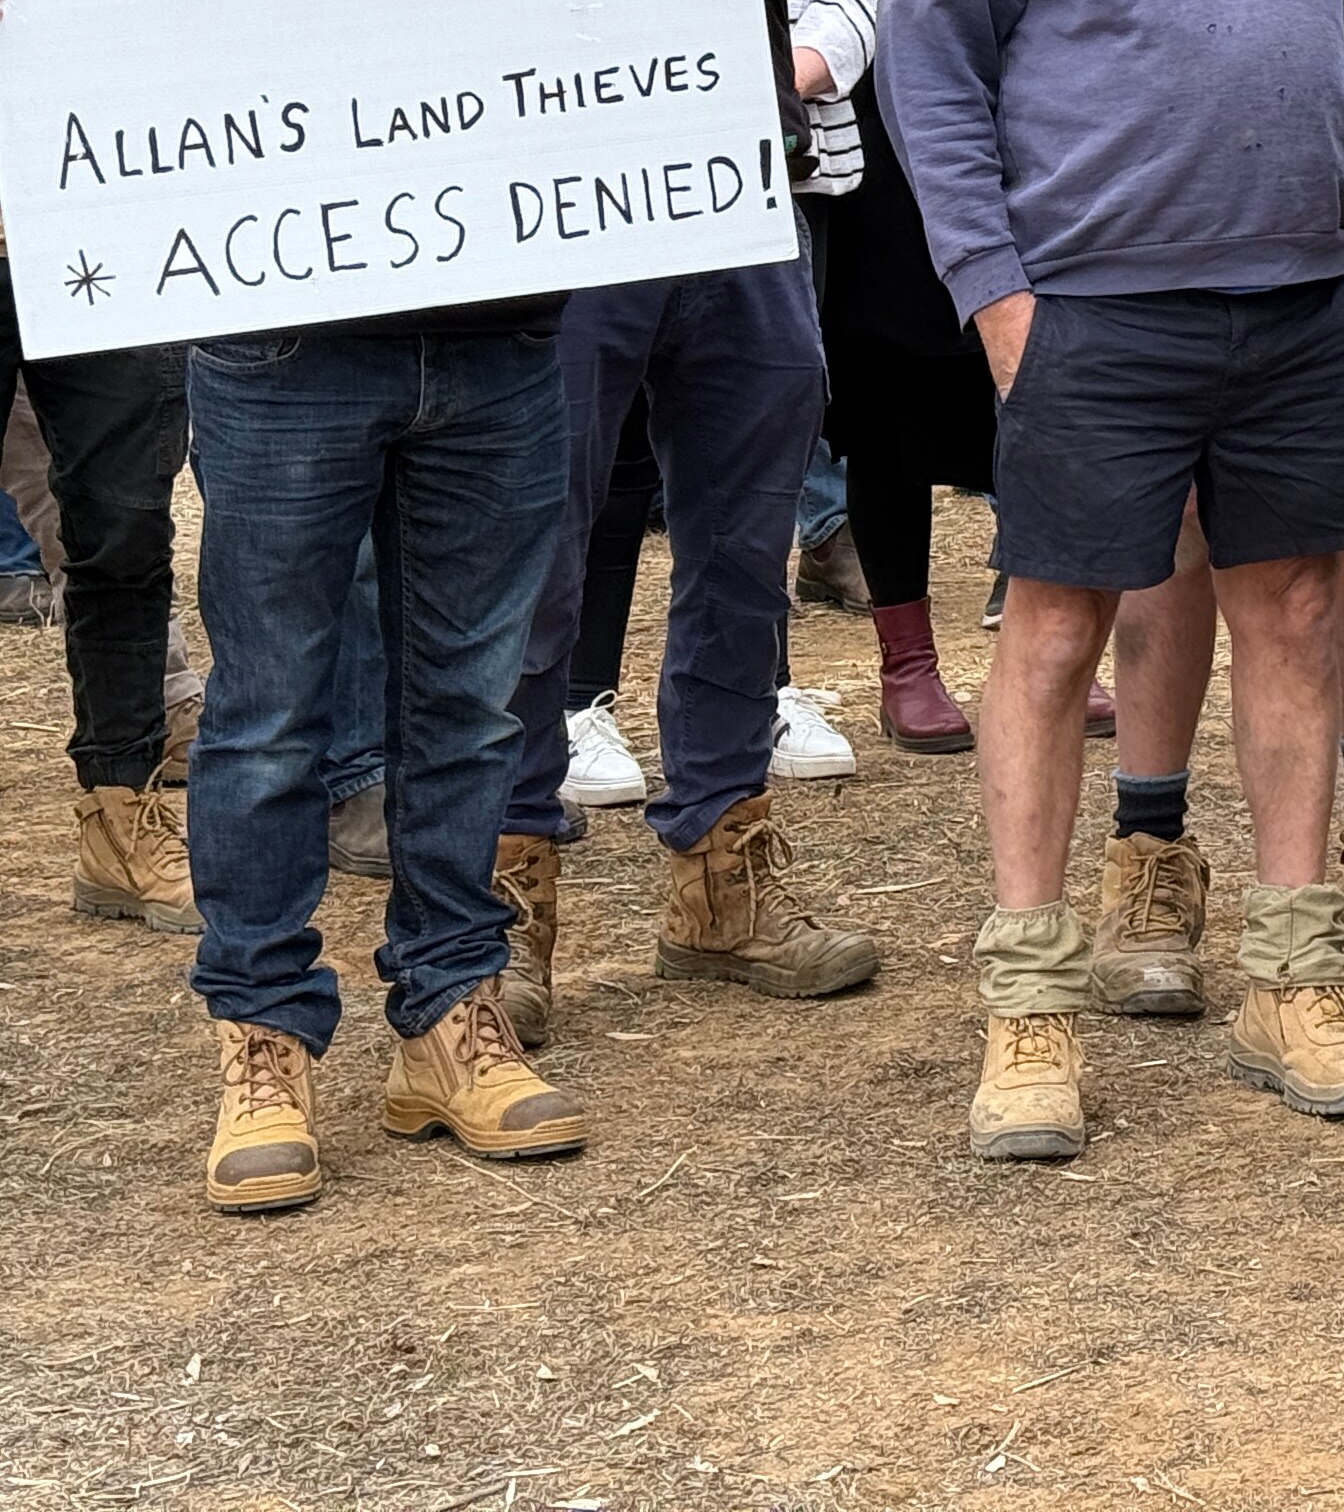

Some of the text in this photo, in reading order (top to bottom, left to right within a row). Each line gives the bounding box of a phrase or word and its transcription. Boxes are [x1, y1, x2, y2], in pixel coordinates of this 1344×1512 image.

[58, 51, 722, 190] ALLAN'S LAND THIEVES
[155, 138, 779, 297] ACCESS DENIED!
